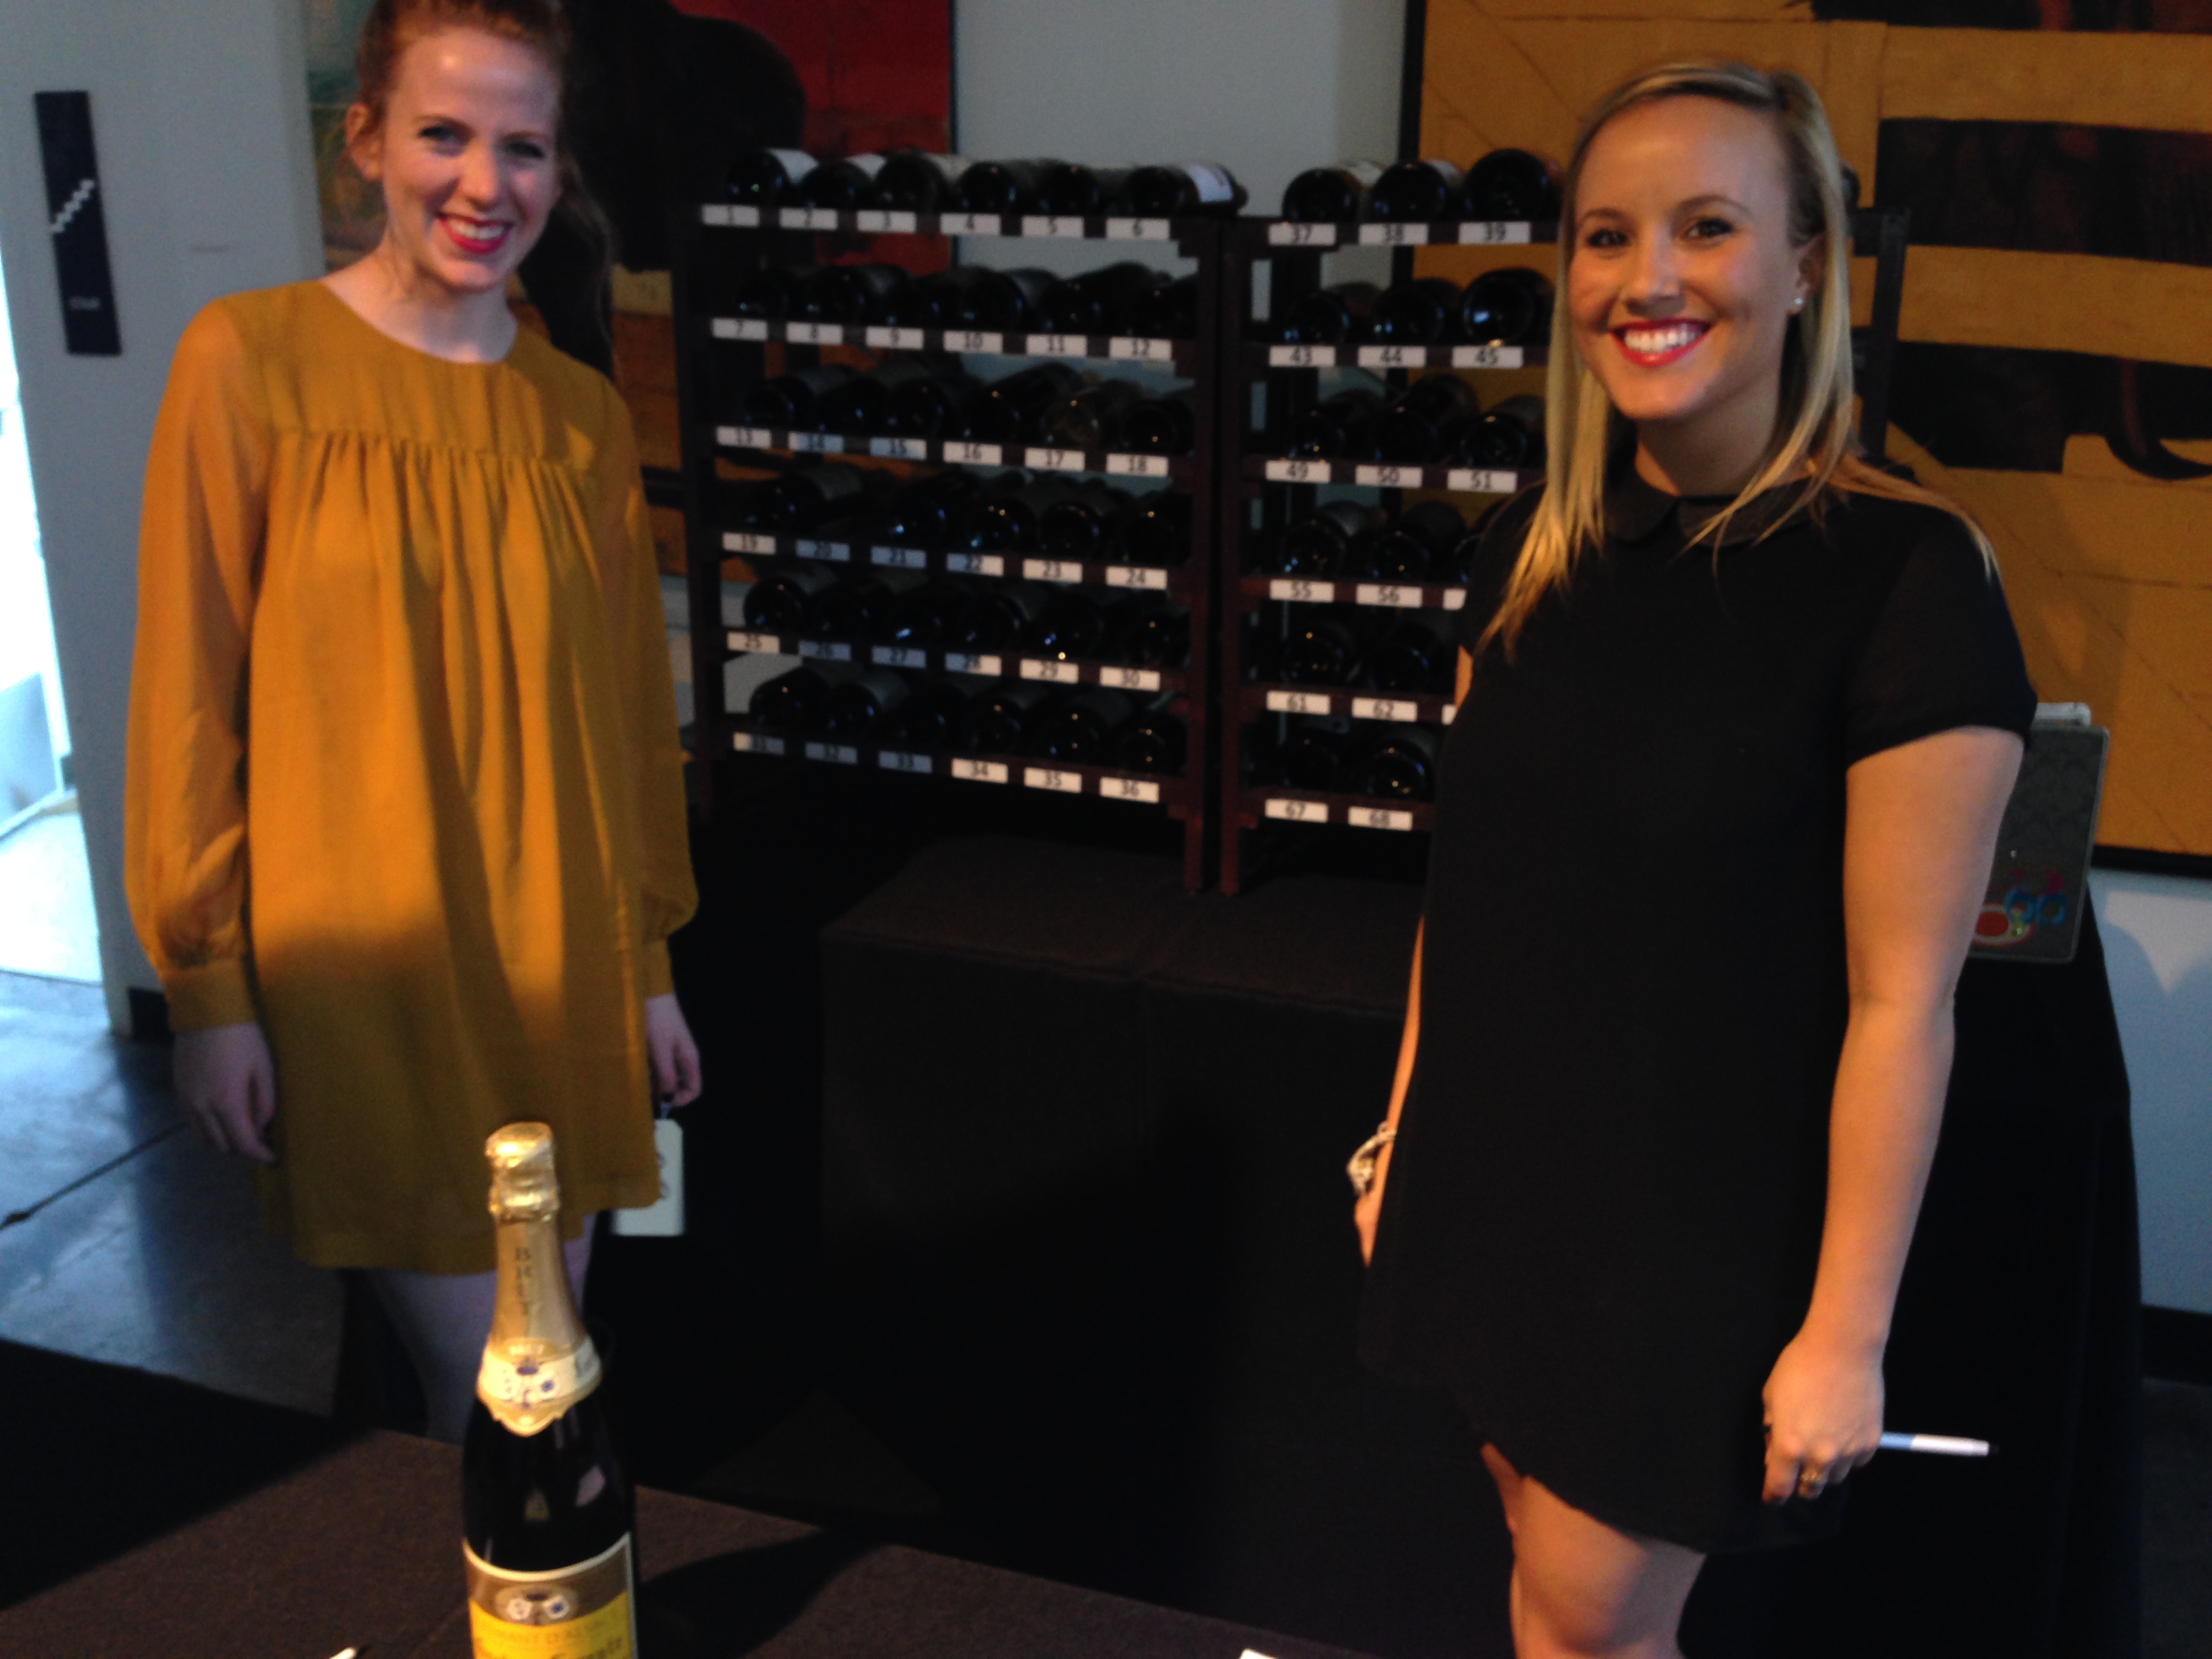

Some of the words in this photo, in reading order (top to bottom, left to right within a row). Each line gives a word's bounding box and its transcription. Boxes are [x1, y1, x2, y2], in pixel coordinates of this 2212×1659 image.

[802, 209, 812, 228] 2
[965, 214, 973, 230] 4
[1048, 217, 1057, 234] 5
[1131, 219, 1142, 237] 6
[1292, 226, 1312, 242] 37
[1485, 224, 1505, 241] 39
[735, 321, 743, 337] 7
[810, 325, 819, 341] 8
[890, 329, 899, 346] 9
[964, 332, 983, 349] 10
[1047, 336, 1065, 352] 11
[1132, 340, 1149, 356] 12
[1291, 347, 1311, 364] 43
[1380, 347, 1401, 363] 44
[1477, 347, 1498, 364] 45
[889, 439, 906, 456] 15
[964, 444, 982, 460] 16
[1046, 450, 1063, 467] 17
[1128, 455, 1147, 472] 18
[1287, 461, 1307, 480] 49
[1378, 467, 1399, 485] 50
[1471, 471, 1491, 489] 51
[741, 535, 758, 551] 19
[1043, 562, 1061, 578] 23
[1126, 569, 1145, 586] 24
[1291, 581, 1311, 598] 55
[1378, 585, 1399, 602] 56
[744, 634, 762, 649] 25
[1040, 661, 1059, 678] 29
[1288, 694, 1306, 711] 61
[1374, 700, 1393, 717] 62
[971, 762, 988, 777] 34
[1044, 771, 1061, 787] 35
[1121, 781, 1139, 798] 36
[1285, 800, 1305, 817] 67
